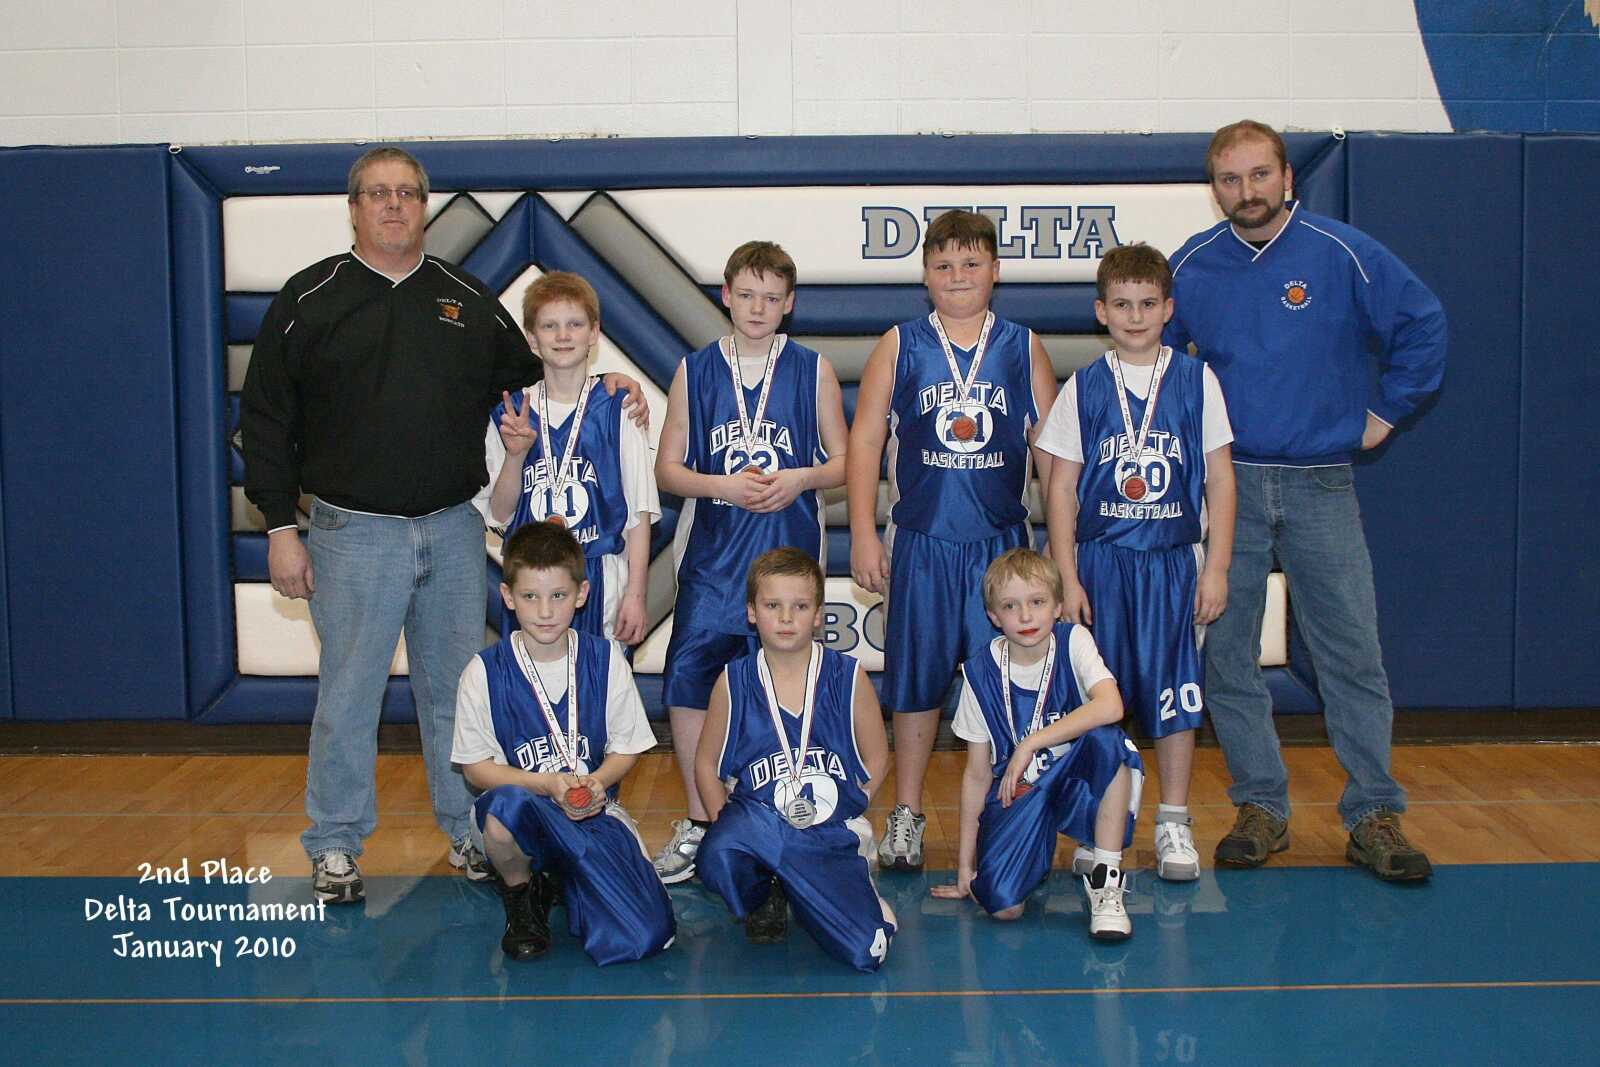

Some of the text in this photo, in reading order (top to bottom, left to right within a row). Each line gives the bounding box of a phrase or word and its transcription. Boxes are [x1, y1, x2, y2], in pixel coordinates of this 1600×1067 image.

[921, 450, 1005, 470] BASKETBALL
[544, 486, 577, 518] 11
[1099, 500, 1183, 520] BASKETBALL
[1160, 682, 1203, 721] 20
[869, 928, 888, 965] 4
